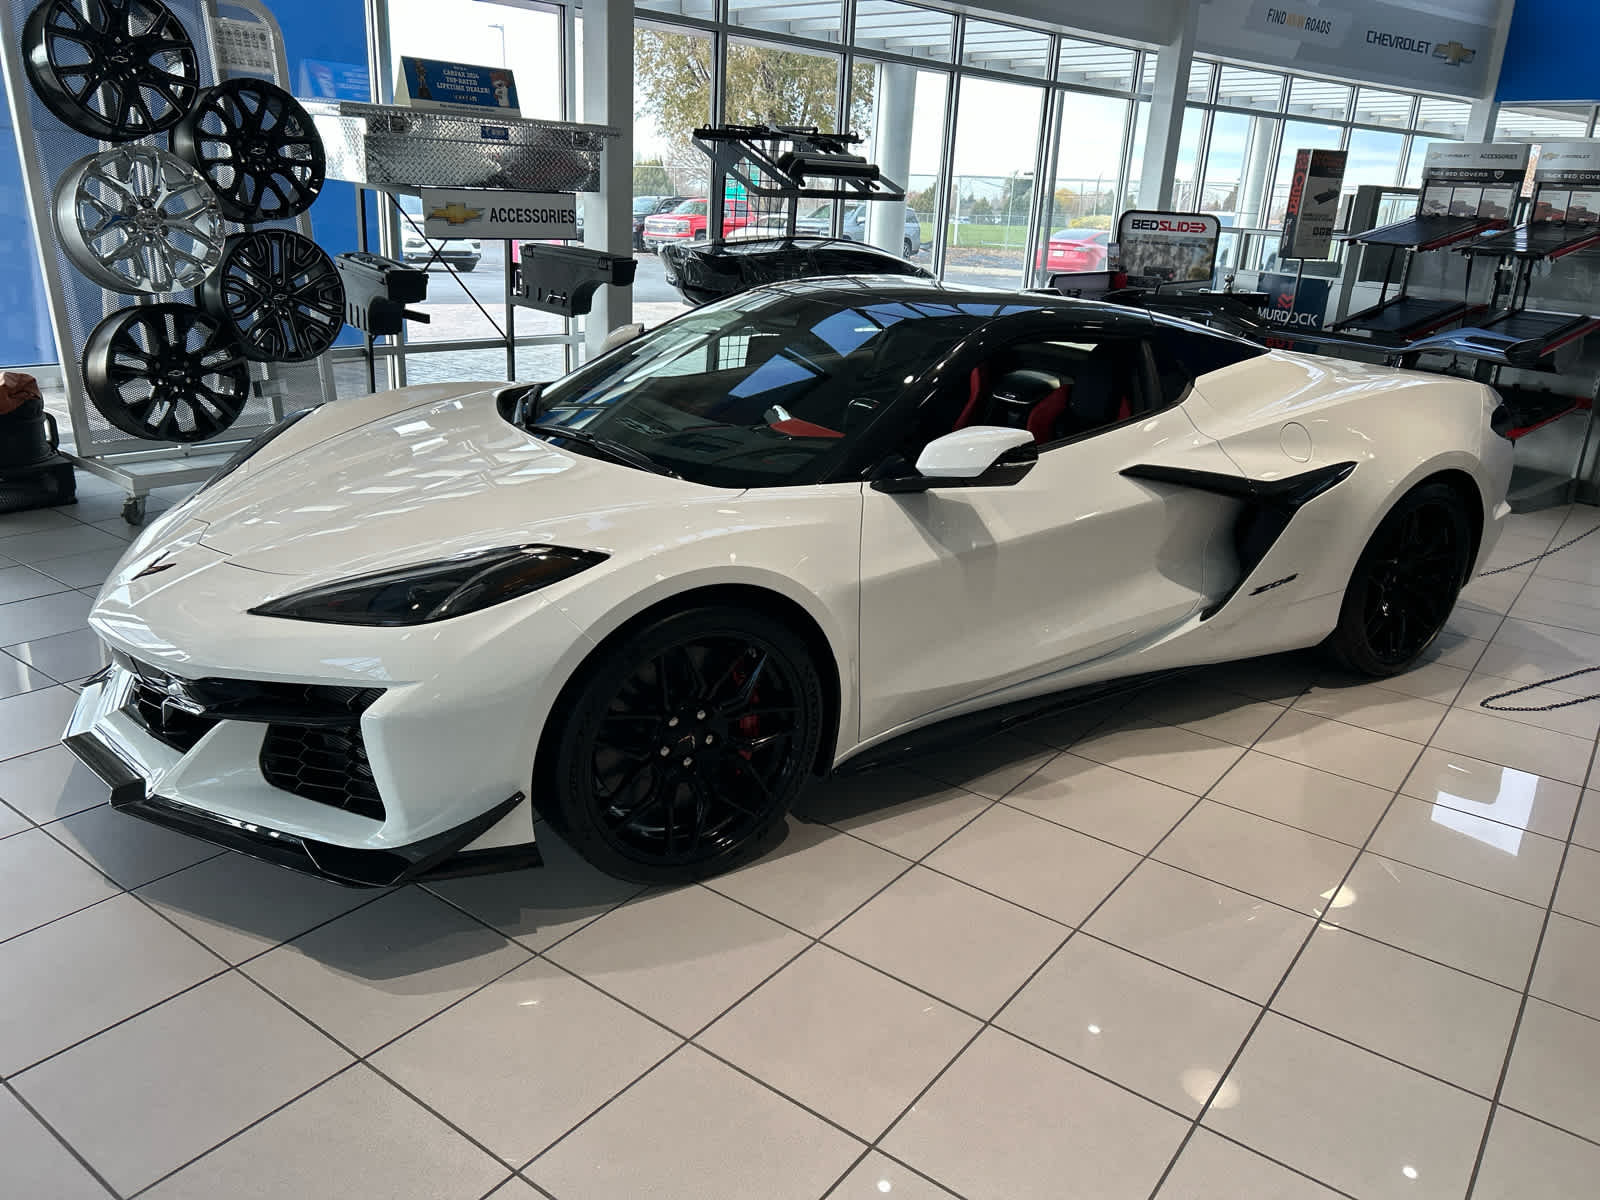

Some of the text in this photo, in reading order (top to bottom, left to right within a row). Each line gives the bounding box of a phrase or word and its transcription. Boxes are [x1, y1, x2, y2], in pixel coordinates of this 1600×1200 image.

[1266, 8, 1286, 25] FIND
[1304, 16, 1332, 35] ROADS
[1366, 30, 1432, 54] CHEVROLET
[489, 207, 575, 224] ACCESSORIES
[1131, 219, 1207, 234] BEDSLIDE
[1257, 306, 1318, 327] MURDOCK
